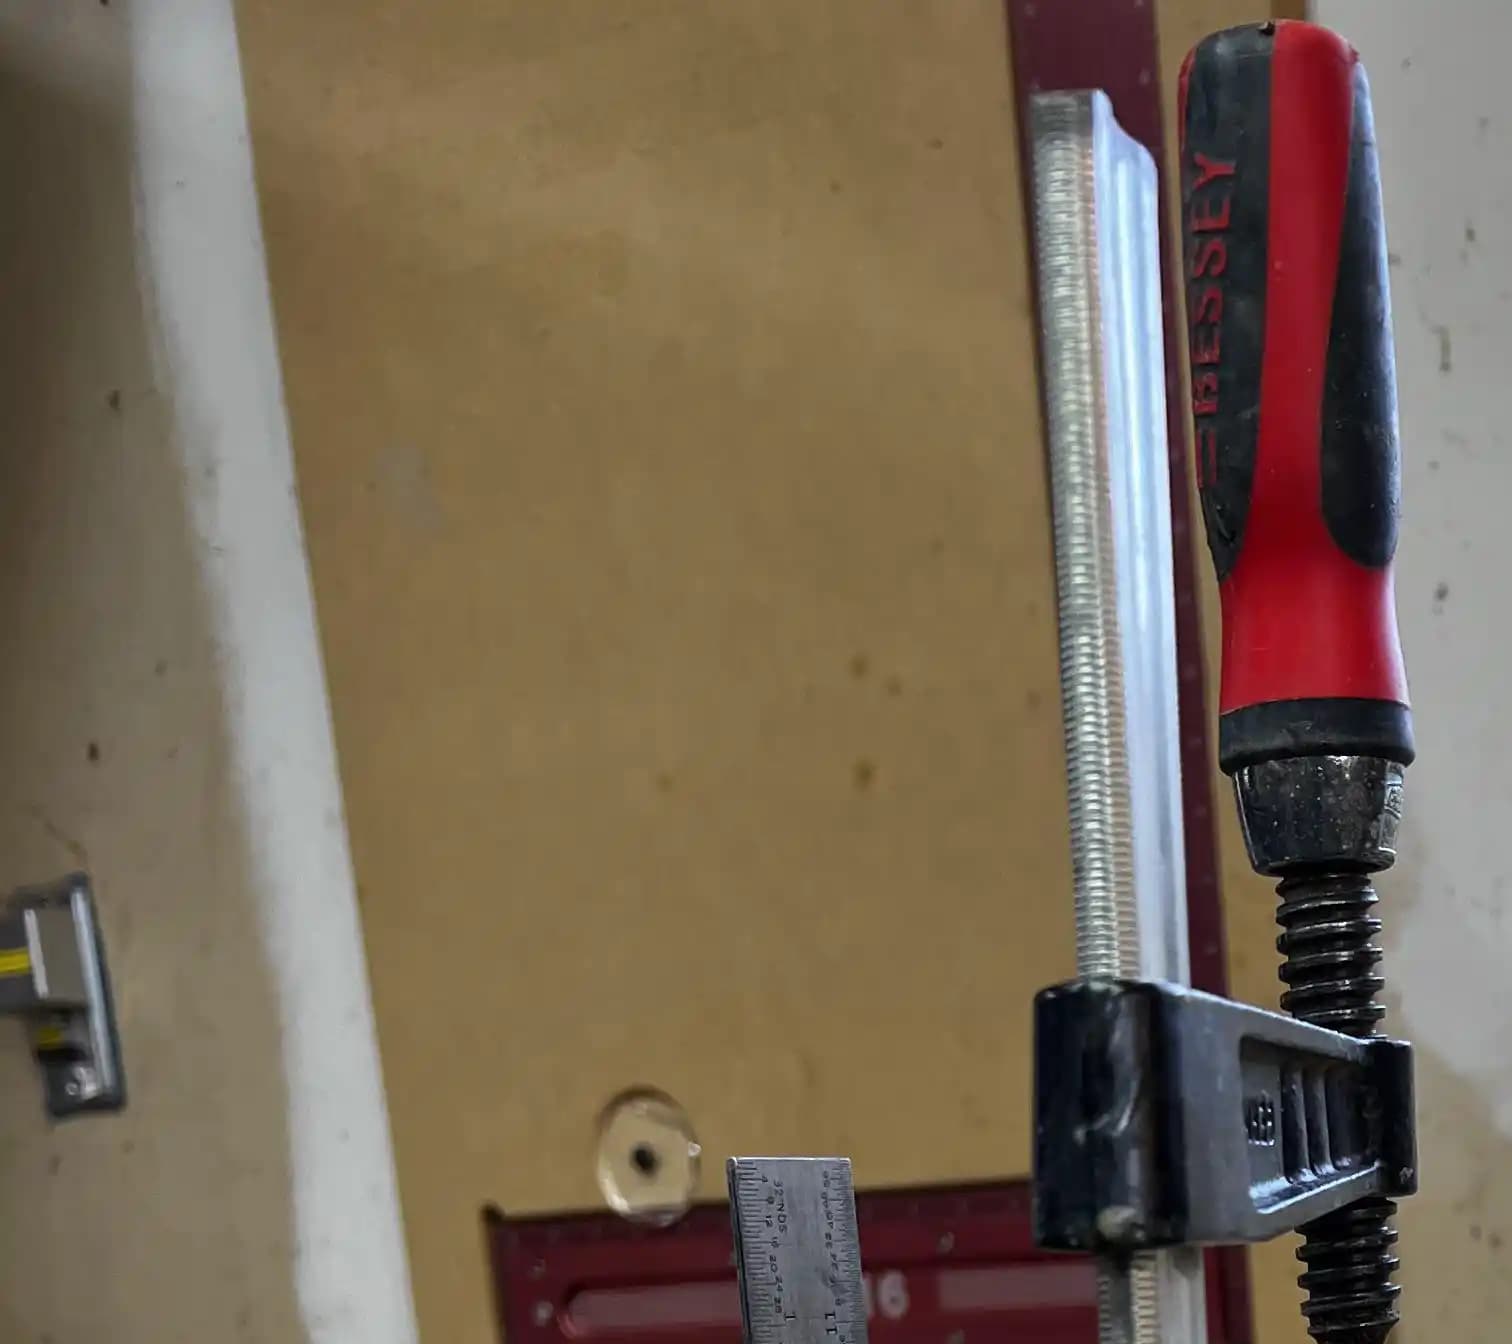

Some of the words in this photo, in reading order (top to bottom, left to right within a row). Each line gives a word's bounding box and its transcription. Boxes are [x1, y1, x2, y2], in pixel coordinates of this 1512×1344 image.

[1191, 154, 1238, 416] BESSEY
[765, 1215, 773, 1227] 12
[769, 1255, 778, 1273] 20
[774, 1276, 783, 1291] 24
[784, 1311, 796, 1321] 1
[824, 1312, 838, 1335] 11
